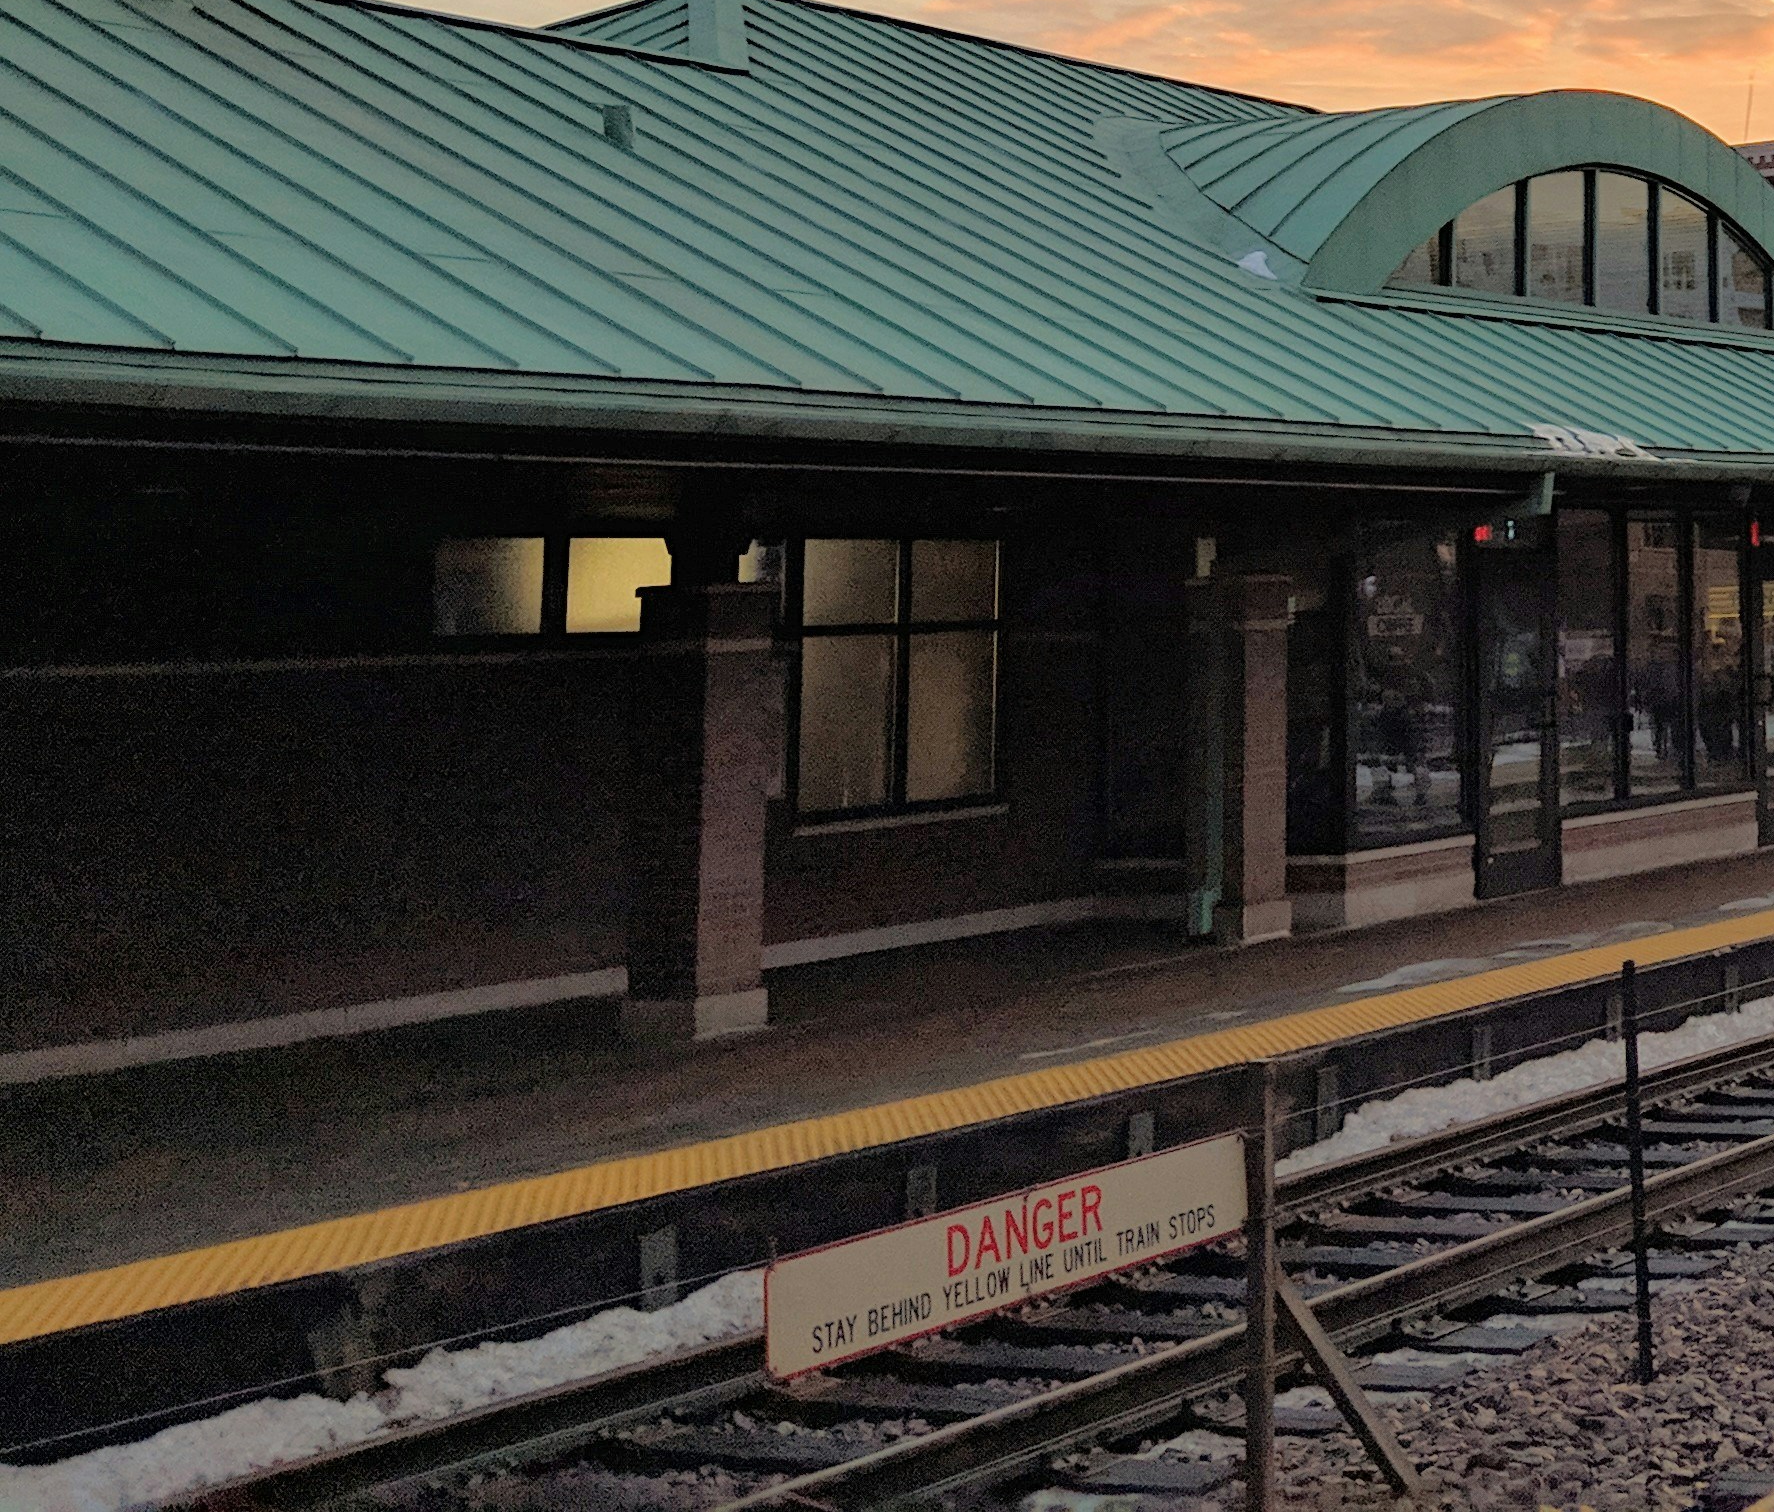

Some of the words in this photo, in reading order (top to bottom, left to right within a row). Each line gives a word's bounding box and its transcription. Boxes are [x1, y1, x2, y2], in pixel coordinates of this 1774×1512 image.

[812, 1314, 857, 1354] STAY
[867, 1292, 932, 1337] BEHIND
[943, 1266, 1010, 1311] YELLOW
[1020, 1253, 1054, 1288] LINE
[1063, 1238, 1107, 1273] UNTIL
[1116, 1220, 1161, 1256] TRAIN
[1168, 1203, 1216, 1240] STOPS
[946, 1184, 1103, 1277] DANGER
